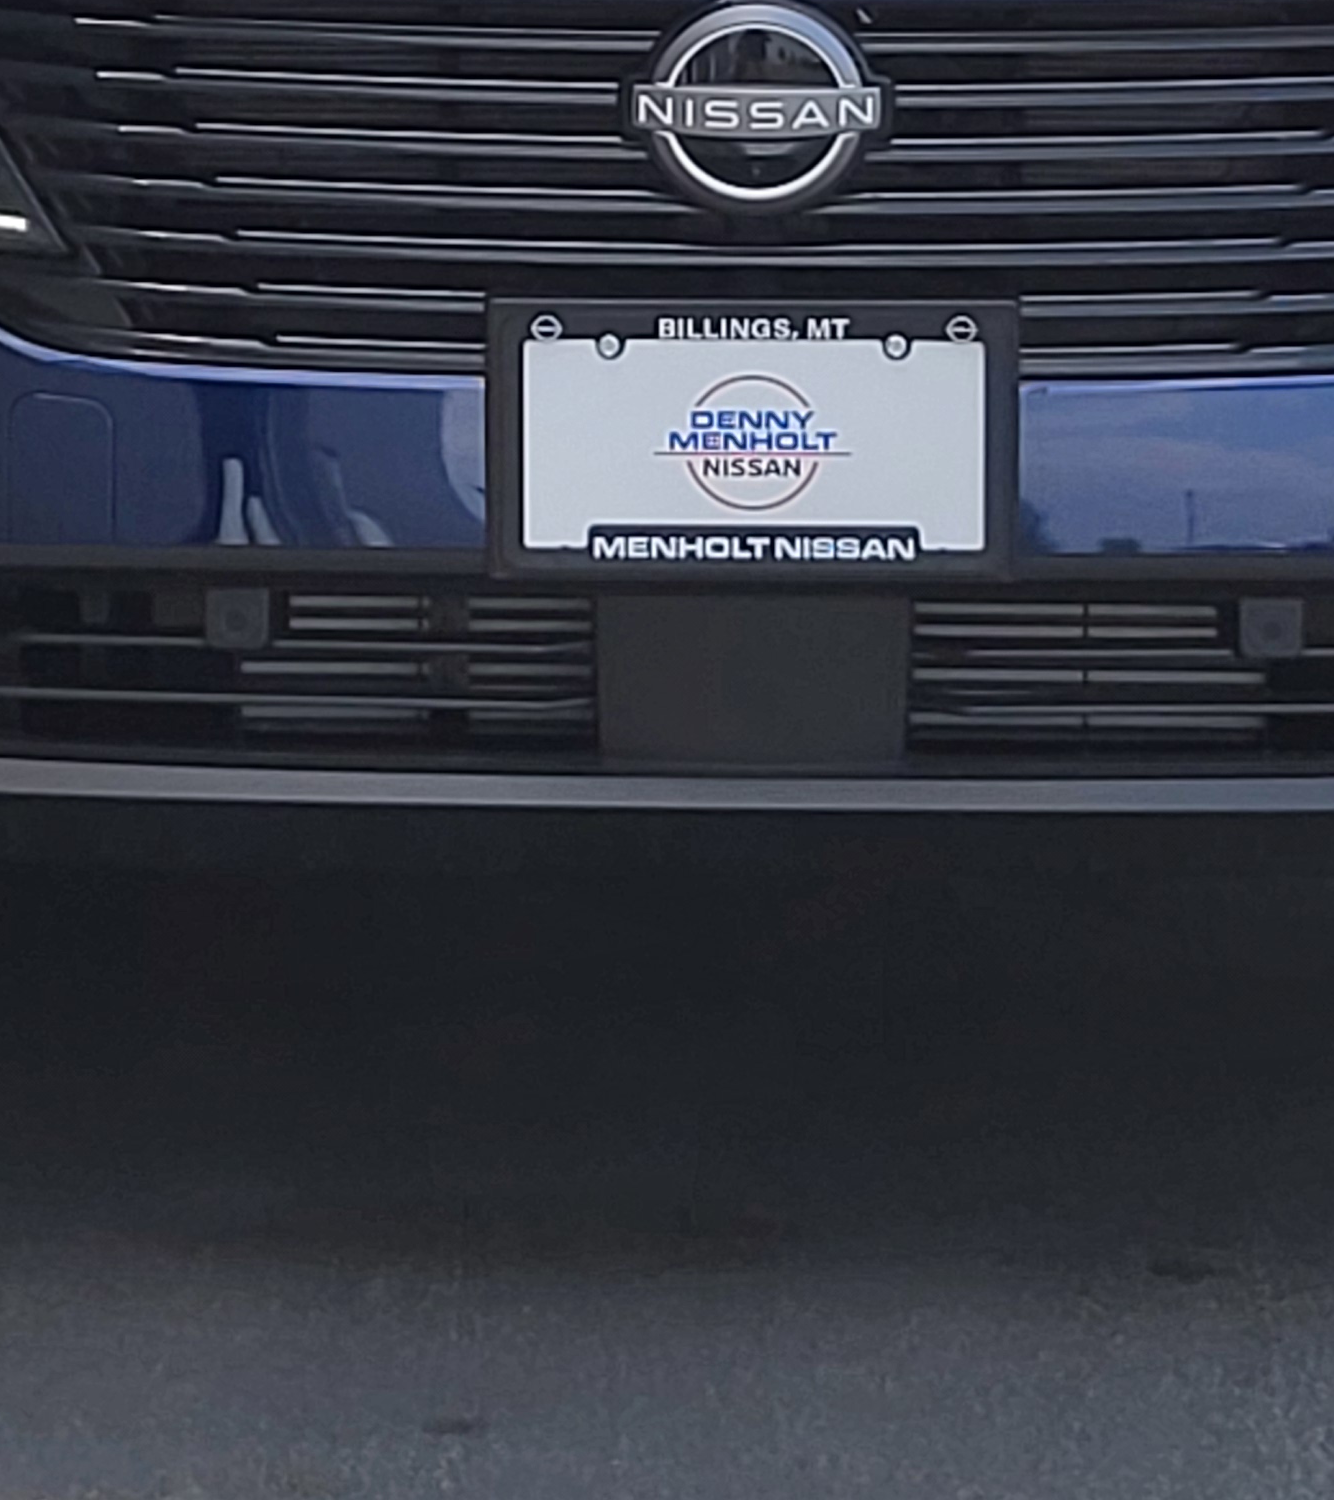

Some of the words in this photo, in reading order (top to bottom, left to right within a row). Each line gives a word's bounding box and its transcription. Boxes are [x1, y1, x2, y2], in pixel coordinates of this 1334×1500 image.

[637, 94, 875, 129] NISSAN
[657, 317, 800, 341] BILLINGS,
[807, 318, 852, 341] MT
[689, 410, 815, 430] DENNY
[667, 431, 838, 451] MENHOLT
[701, 457, 803, 478] NISSAN
[591, 535, 770, 560] MENHOLT
[774, 535, 917, 560] NISSAN
